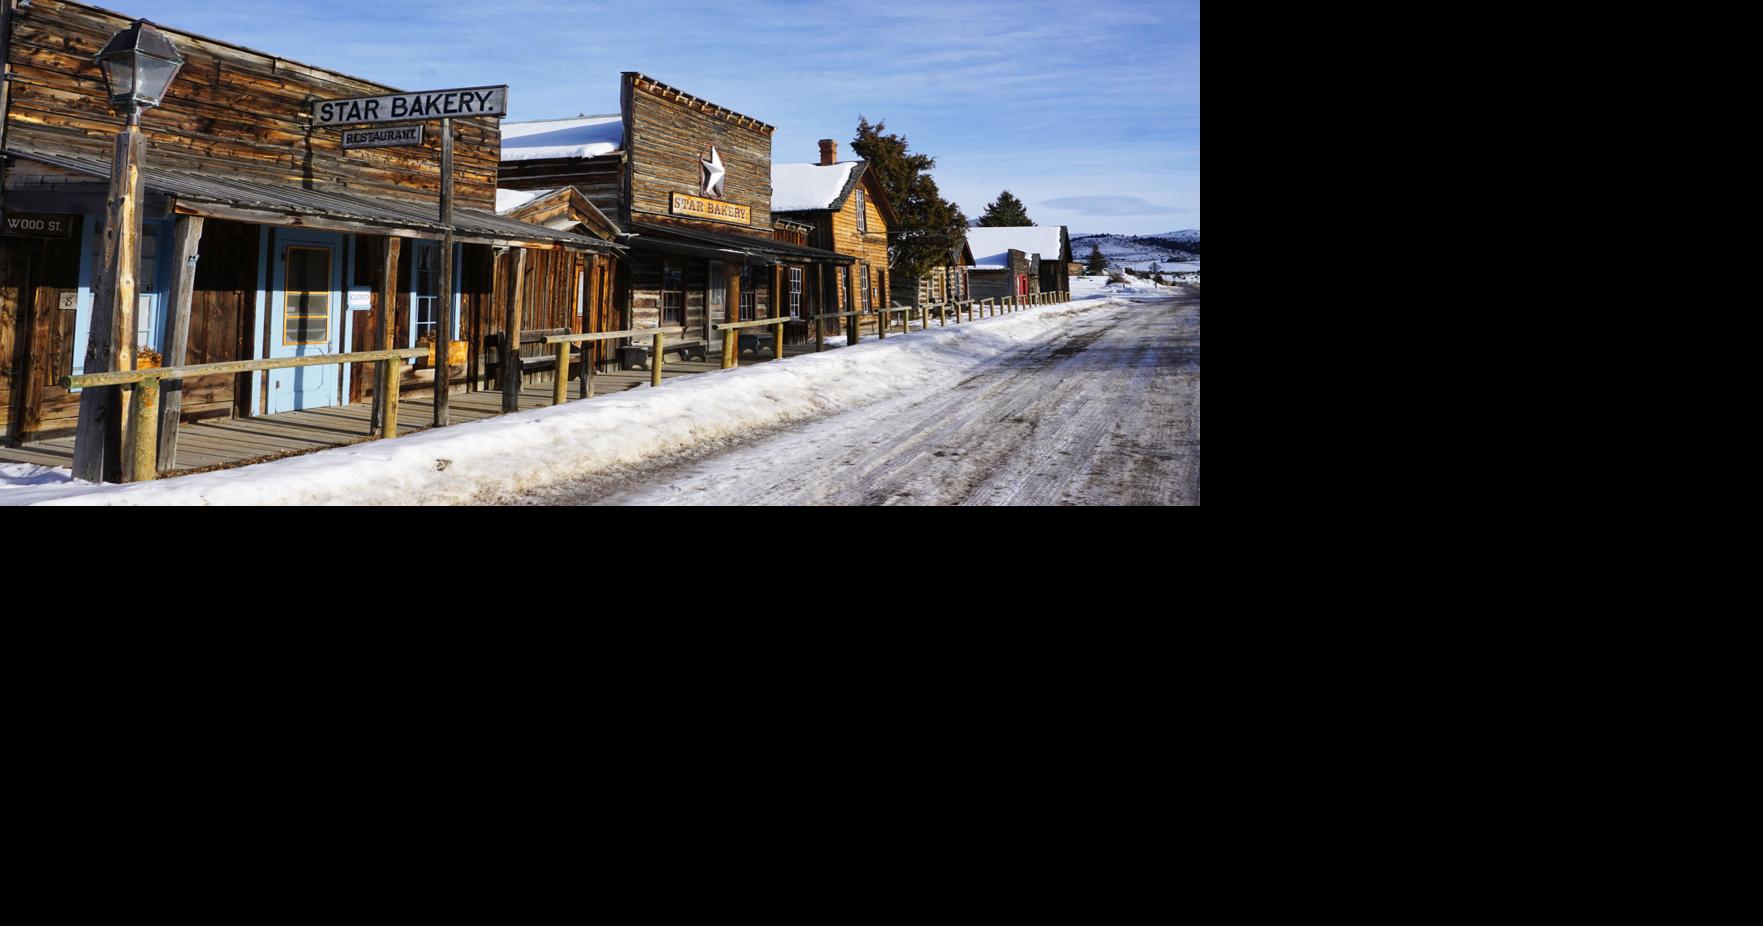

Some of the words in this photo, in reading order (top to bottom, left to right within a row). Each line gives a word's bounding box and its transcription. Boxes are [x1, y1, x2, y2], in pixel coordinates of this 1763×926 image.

[320, 100, 379, 122] STAR
[391, 91, 494, 118] BAKERY.
[674, 197, 704, 213] STAR
[707, 202, 749, 220] BAKERY.
[7, 218, 45, 230] WOOD
[48, 221, 62, 231] ST.
